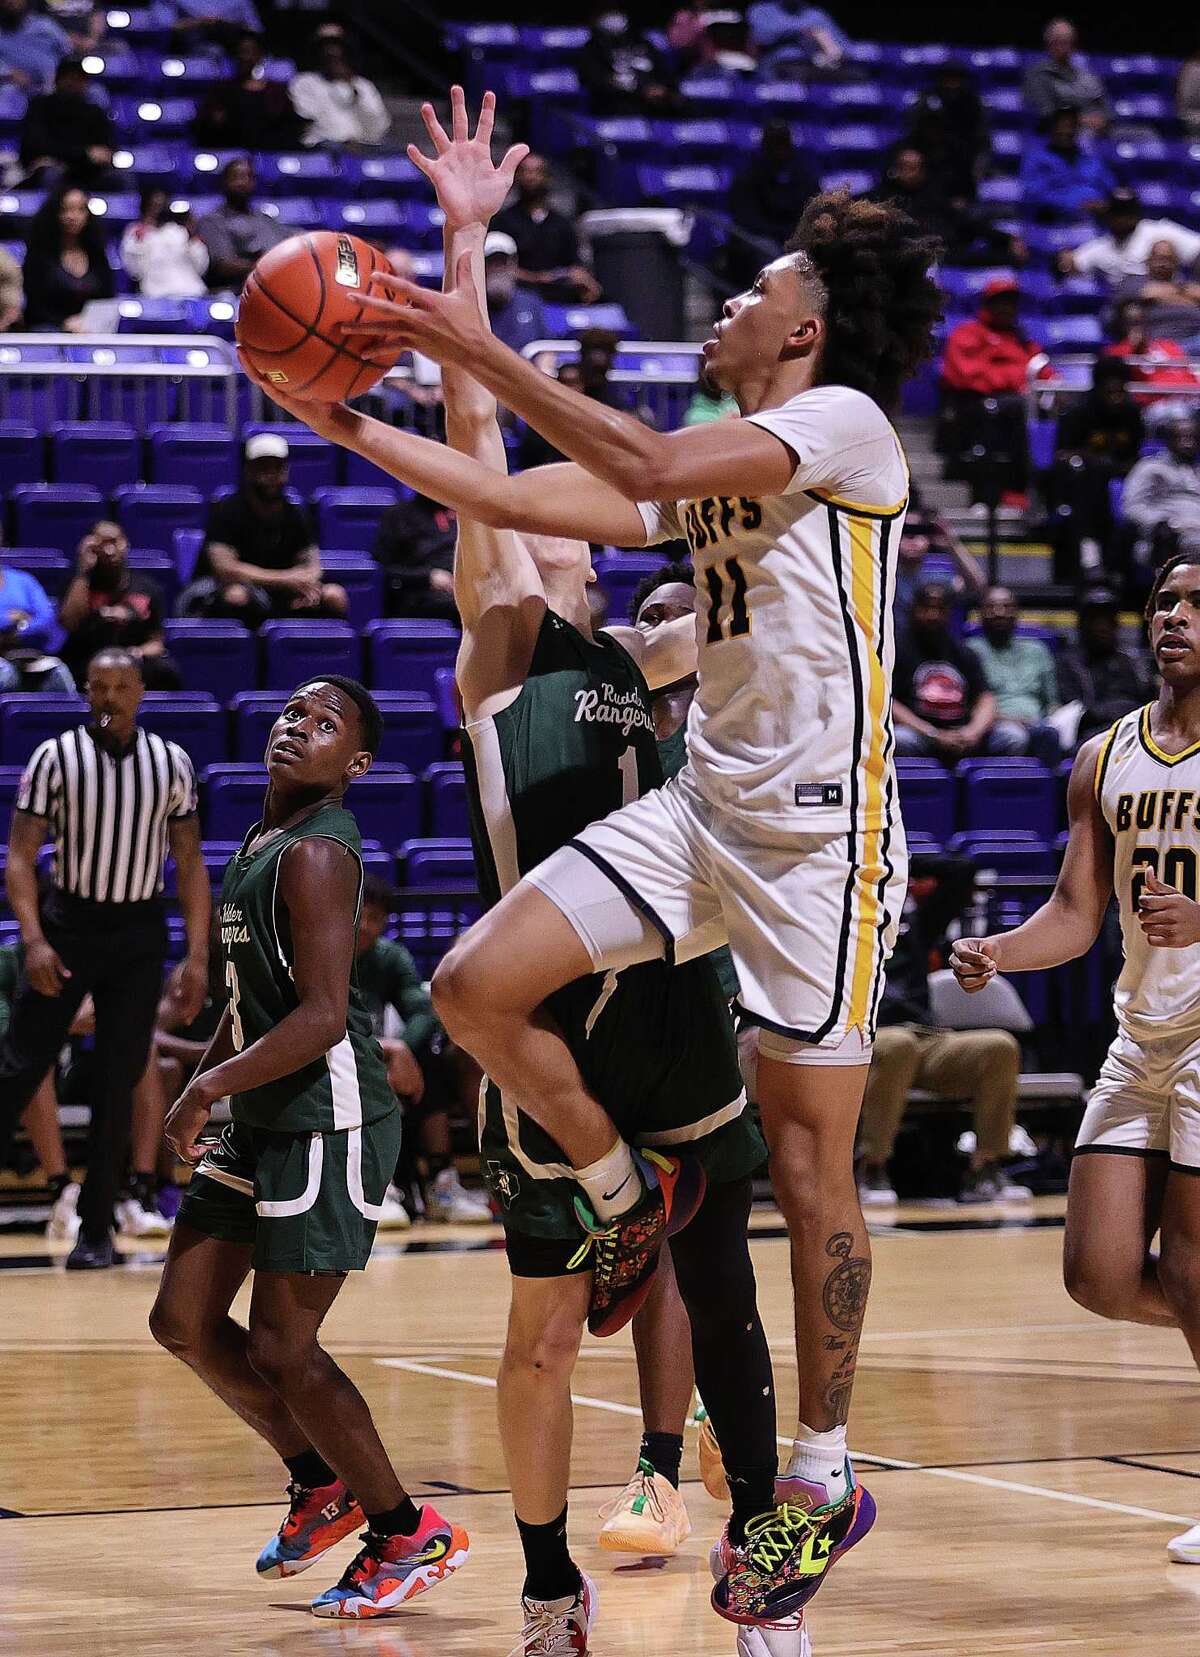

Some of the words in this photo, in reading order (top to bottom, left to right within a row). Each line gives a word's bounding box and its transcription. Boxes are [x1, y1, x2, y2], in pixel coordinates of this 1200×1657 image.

[685, 497, 762, 553] UFFS
[705, 558, 751, 644] 11
[828, 789, 838, 800] M
[320, 1502, 340, 1520] 13
